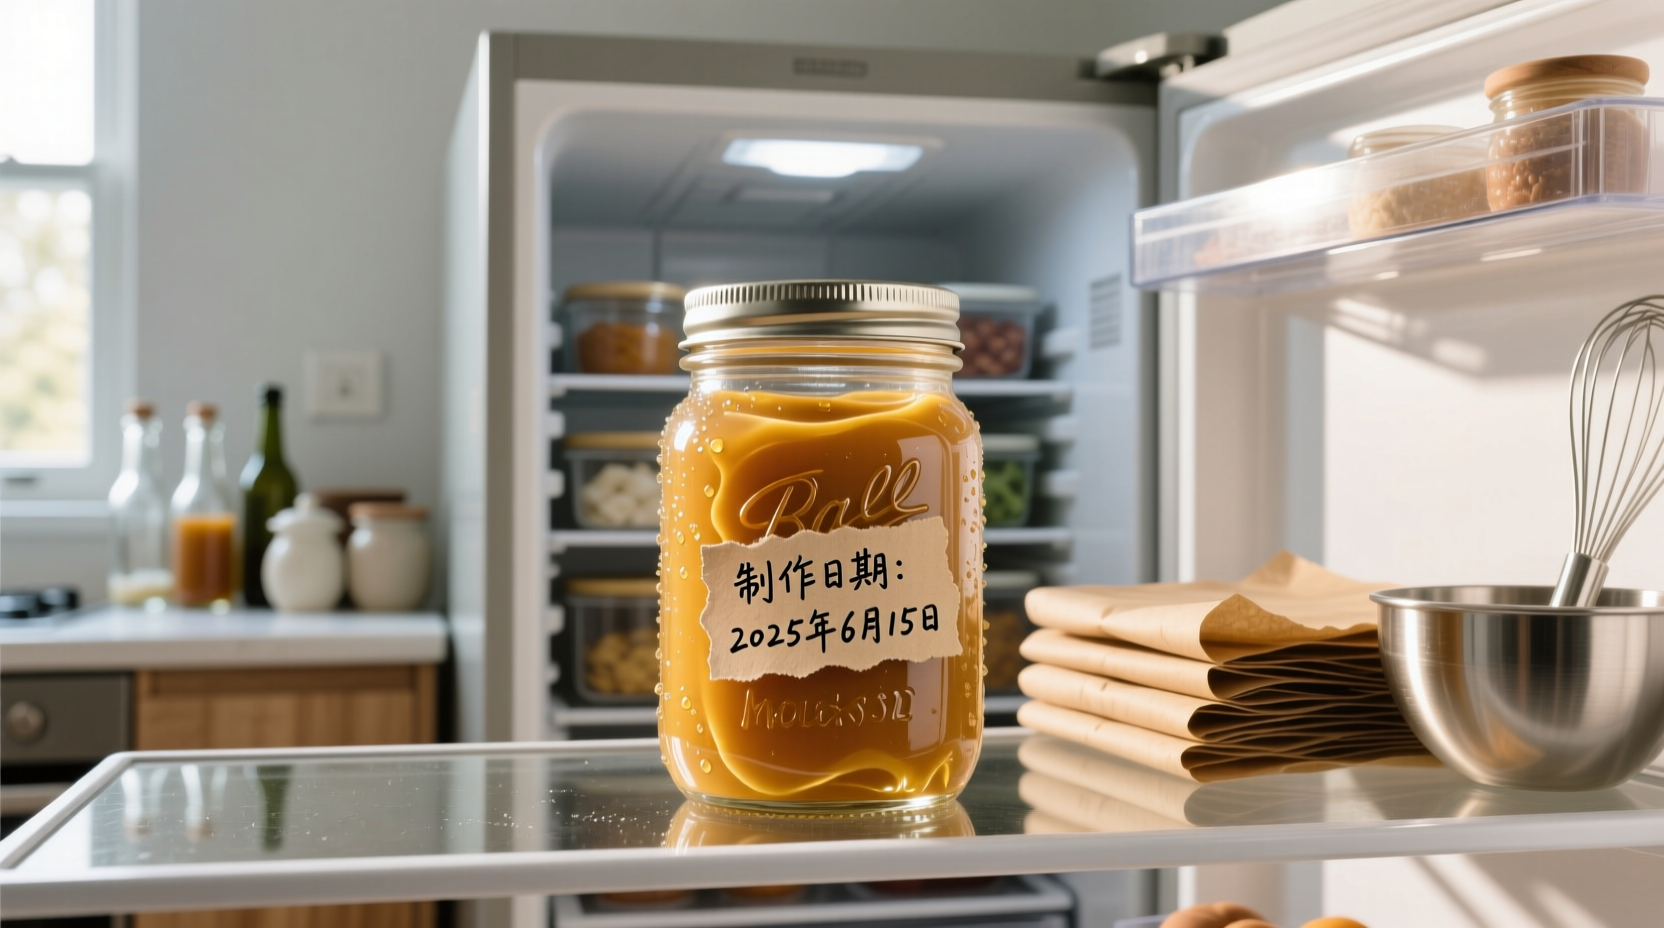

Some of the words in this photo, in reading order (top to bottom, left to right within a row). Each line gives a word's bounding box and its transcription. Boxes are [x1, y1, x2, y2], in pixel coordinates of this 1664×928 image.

[739, 457, 930, 537] Ball
[733, 547, 904, 605] 制作日期：
[729, 603, 939, 654] 2025年6月15日
